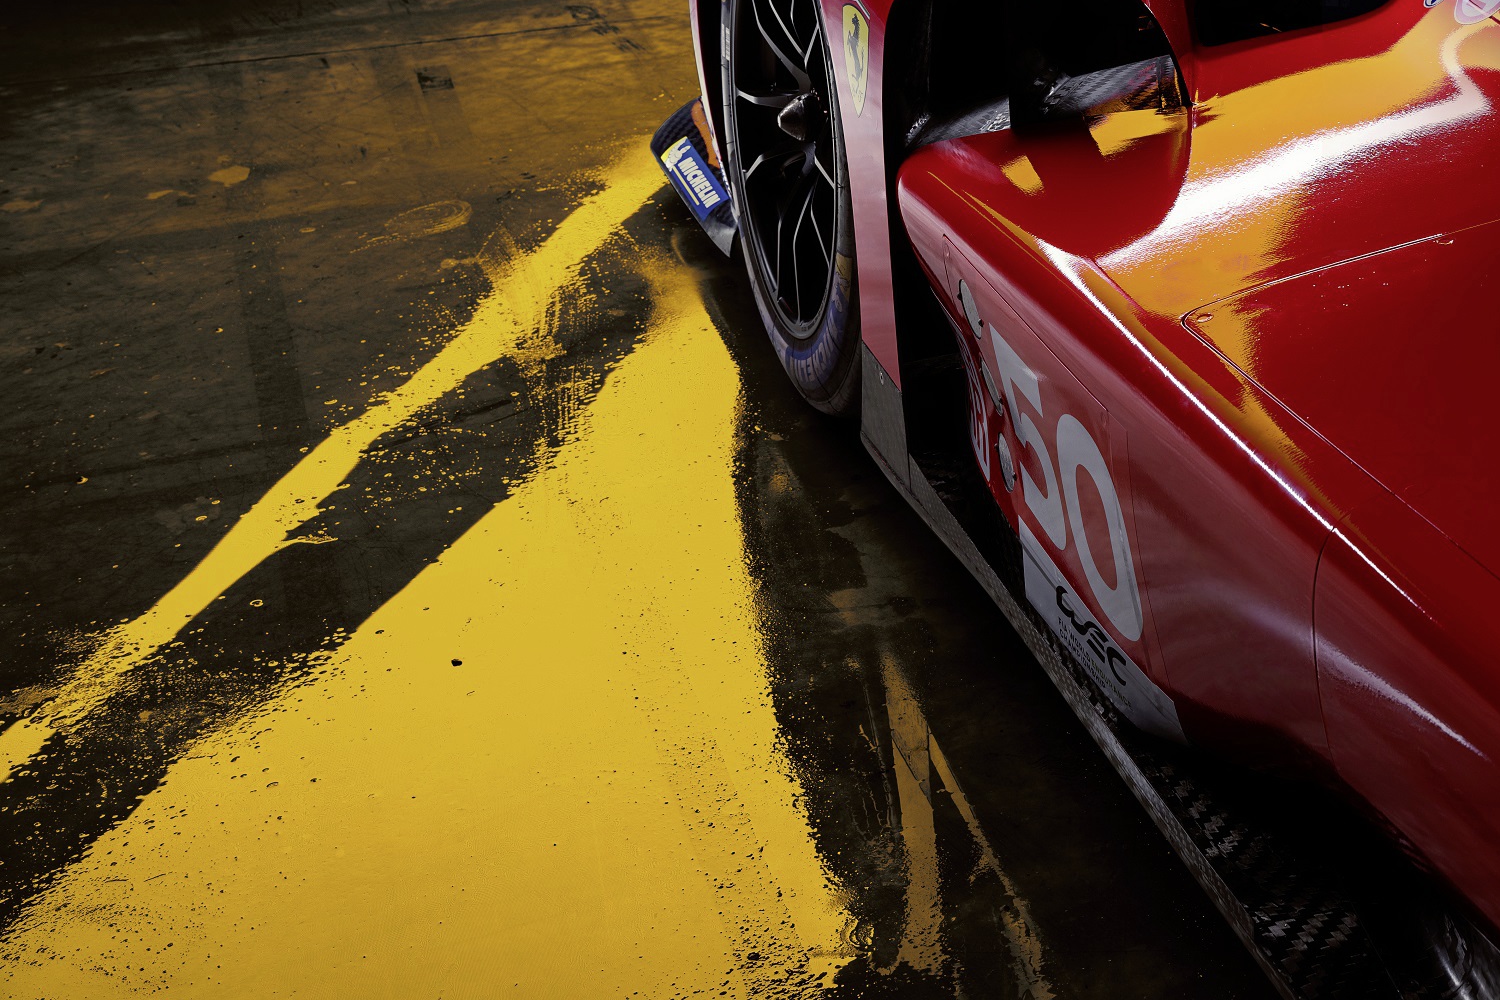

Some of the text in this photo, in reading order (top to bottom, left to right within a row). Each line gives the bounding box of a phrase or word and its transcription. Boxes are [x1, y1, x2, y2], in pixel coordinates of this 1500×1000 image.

[677, 156, 721, 209] MICHELIN
[989, 323, 1143, 642] 50
[1056, 585, 1127, 687] WEC
